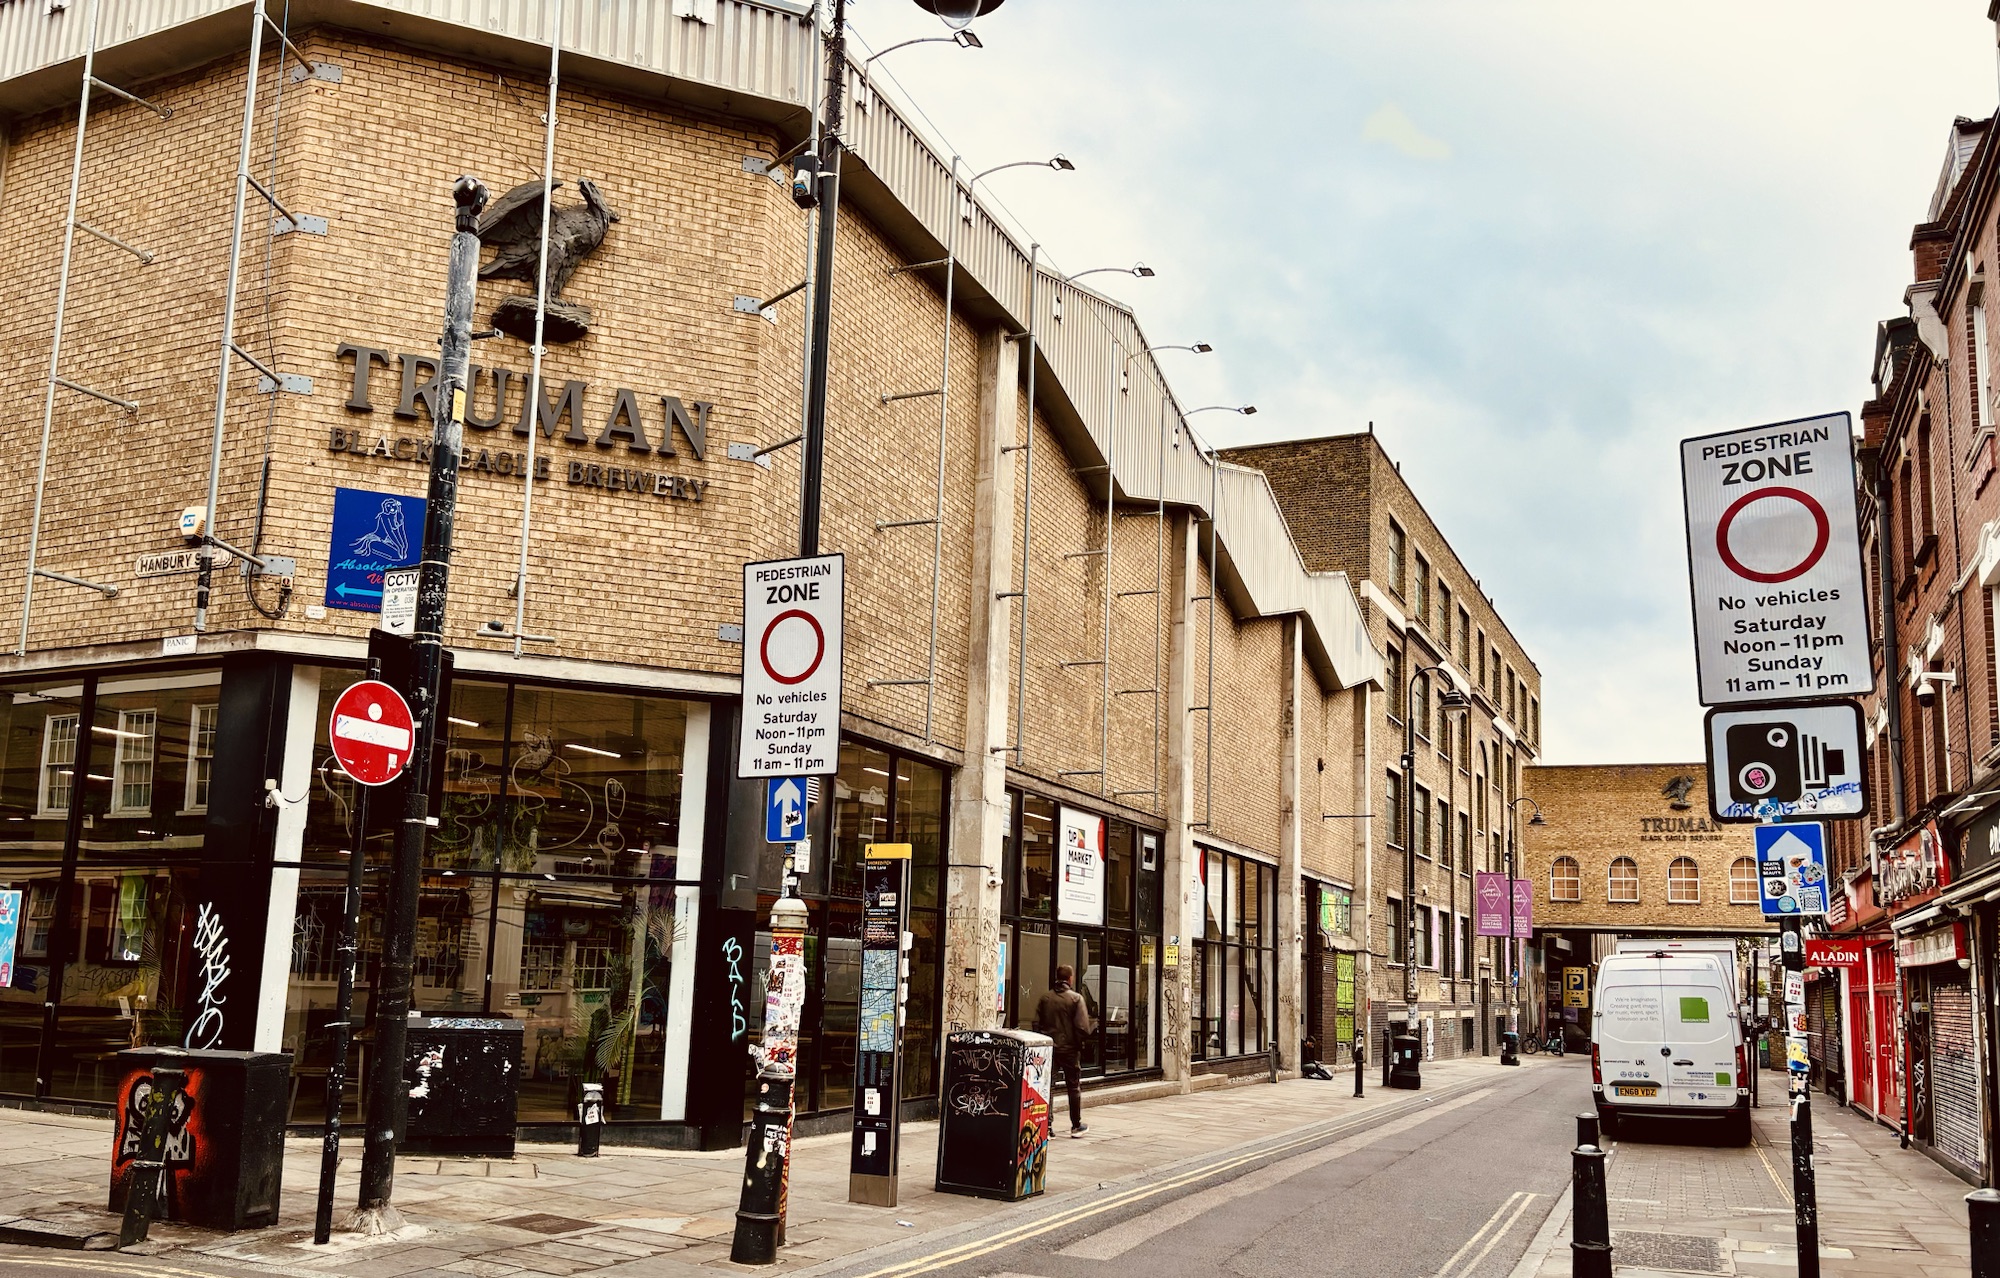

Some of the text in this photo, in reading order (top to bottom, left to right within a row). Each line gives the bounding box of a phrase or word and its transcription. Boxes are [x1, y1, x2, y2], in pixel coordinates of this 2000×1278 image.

[336, 342, 713, 460] TRUMAN
[1702, 426, 1829, 460] PEDESTRIAN
[329, 427, 710, 501] BLACK EAGLE BREWERY
[1722, 451, 1813, 485] ZONE
[140, 553, 192, 573] HANBURY
[387, 573, 419, 587] CCTV
[756, 564, 831, 582] PEDESTRIAN
[391, 586, 418, 594] OPERATION
[766, 582, 820, 604] ZONE
[1719, 587, 1840, 611] No vehicles
[1734, 614, 1827, 634] Saturday
[166, 637, 189, 647] PANIC
[1724, 639, 1776, 655] Noon
[1748, 655, 1823, 672] Sunday
[756, 691, 827, 705] No vehicles
[763, 711, 818, 724] Saturday
[756, 729, 787, 740] Noon
[767, 742, 812, 755] Sunday
[1640, 817, 1723, 833] TRUMAN
[1068, 849, 1092, 866] MARKET
[1810, 951, 1859, 962] ALADIN
[1569, 975, 1581, 989] P
